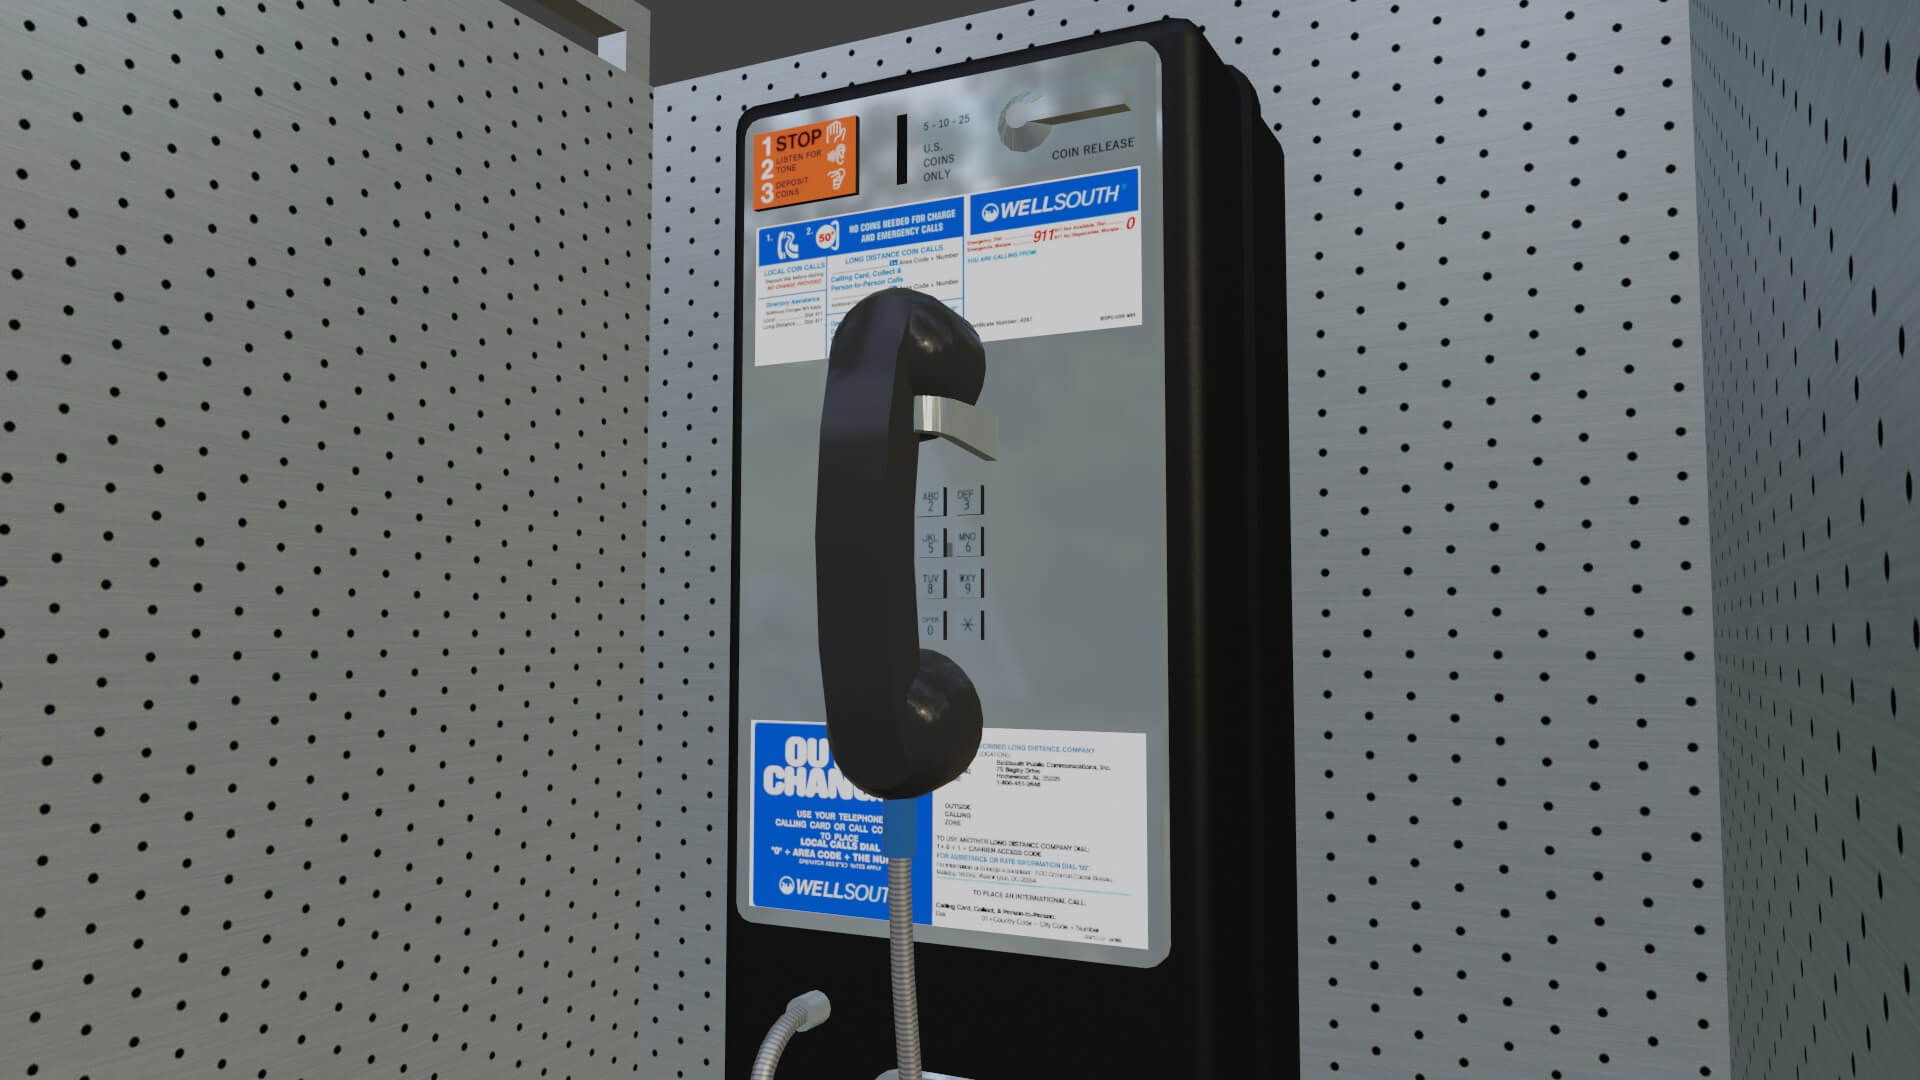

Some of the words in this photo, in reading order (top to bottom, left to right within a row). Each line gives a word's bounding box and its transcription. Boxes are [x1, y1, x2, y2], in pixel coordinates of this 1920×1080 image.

[938, 118, 950, 128] 10
[959, 114, 971, 126] 25
[762, 136, 771, 156] 1
[776, 128, 823, 152] STOP
[924, 142, 944, 154] U.S.
[1052, 148, 1080, 160] COIN
[1084, 137, 1135, 155] RELEASE
[776, 154, 804, 165] LISTEN
[806, 150, 822, 160] FOR
[924, 154, 955, 168] COINS
[761, 159, 774, 180] 2
[776, 164, 797, 174] TONE
[776, 176, 809, 189] DEPOSIT
[924, 170, 951, 182] ONLY
[760, 182, 774, 204] 3
[776, 188, 800, 198] COINS
[1000, 184, 1120, 218] WELLSOUTH
[848, 224, 858, 234] NO
[860, 222, 881, 232] COINS
[882, 217, 910, 229] NEEDED
[912, 214, 926, 224] FOR
[928, 209, 956, 222] CHARGE
[1126, 216, 1136, 230] 0
[861, 233, 876, 242] AND
[877, 226, 920, 240] EMERGENCY
[922, 222, 944, 234] CALLS
[1032, 228, 1056, 242] 911
[845, 255, 864, 265] LONG
[866, 251, 900, 262] DISTANCE
[902, 248, 919, 256] COIN
[920, 244, 944, 254] CALLS
[914, 256, 930, 264] Code
[936, 252, 960, 260] Number
[993, 252, 1018, 260] CALLING
[764, 268, 785, 277] LOCAL
[786, 265, 802, 273] COIN
[804, 262, 826, 270] CALLS
[831, 274, 853, 284] Calling
[872, 268, 896, 277] Collect
[831, 280, 887, 291] Person-to-Person
[888, 276, 904, 284] Calls
[914, 282, 930, 290] Code
[923, 491, 940, 500] ABC
[958, 490, 974, 500] DEF
[928, 501, 934, 512] 2
[964, 500, 970, 510] 3
[922, 533, 938, 542] JKL
[928, 543, 934, 554] 5
[965, 542, 972, 552] 6
[923, 574, 940, 583] TUV
[928, 583, 933, 594] 8
[965, 583, 971, 594] 9
[928, 625, 934, 636] 0
[1008, 744, 1026, 752] LONG
[1028, 744, 1060, 753] DISTANCE
[1062, 746, 1096, 754] COMPANY
[763, 765, 883, 802] CHAN
[944, 802, 971, 810] OUTSIDE
[797, 810, 812, 819] USE
[815, 812, 836, 821] YOUR
[838, 813, 884, 824] TELEPHONE
[944, 811, 972, 819] CALLING
[776, 818, 806, 829] CALLING
[810, 822, 831, 830] CARD
[834, 823, 846, 831] OR
[848, 824, 868, 833] CALL
[944, 819, 962, 827] ZONE
[820, 832, 830, 840] TO
[834, 834, 859, 843] PLACE
[960, 837, 989, 845] ANOTHER
[1008, 840, 1040, 848] DISTANCE
[1040, 842, 1073, 851] COMPANY
[800, 838, 828, 848] LOCAL
[830, 840, 858, 850] CALLS
[860, 843, 881, 852] DIAL
[792, 848, 816, 858] AREA
[817, 850, 842, 861] CODE
[852, 854, 871, 864] THE
[950, 854, 988, 863] ASSISTANCE
[796, 878, 889, 904] WELLSOUT
[982, 890, 1004, 898] PLACE
[1016, 894, 1067, 904] INTERNATIONAL
[936, 902, 956, 911] Calling
